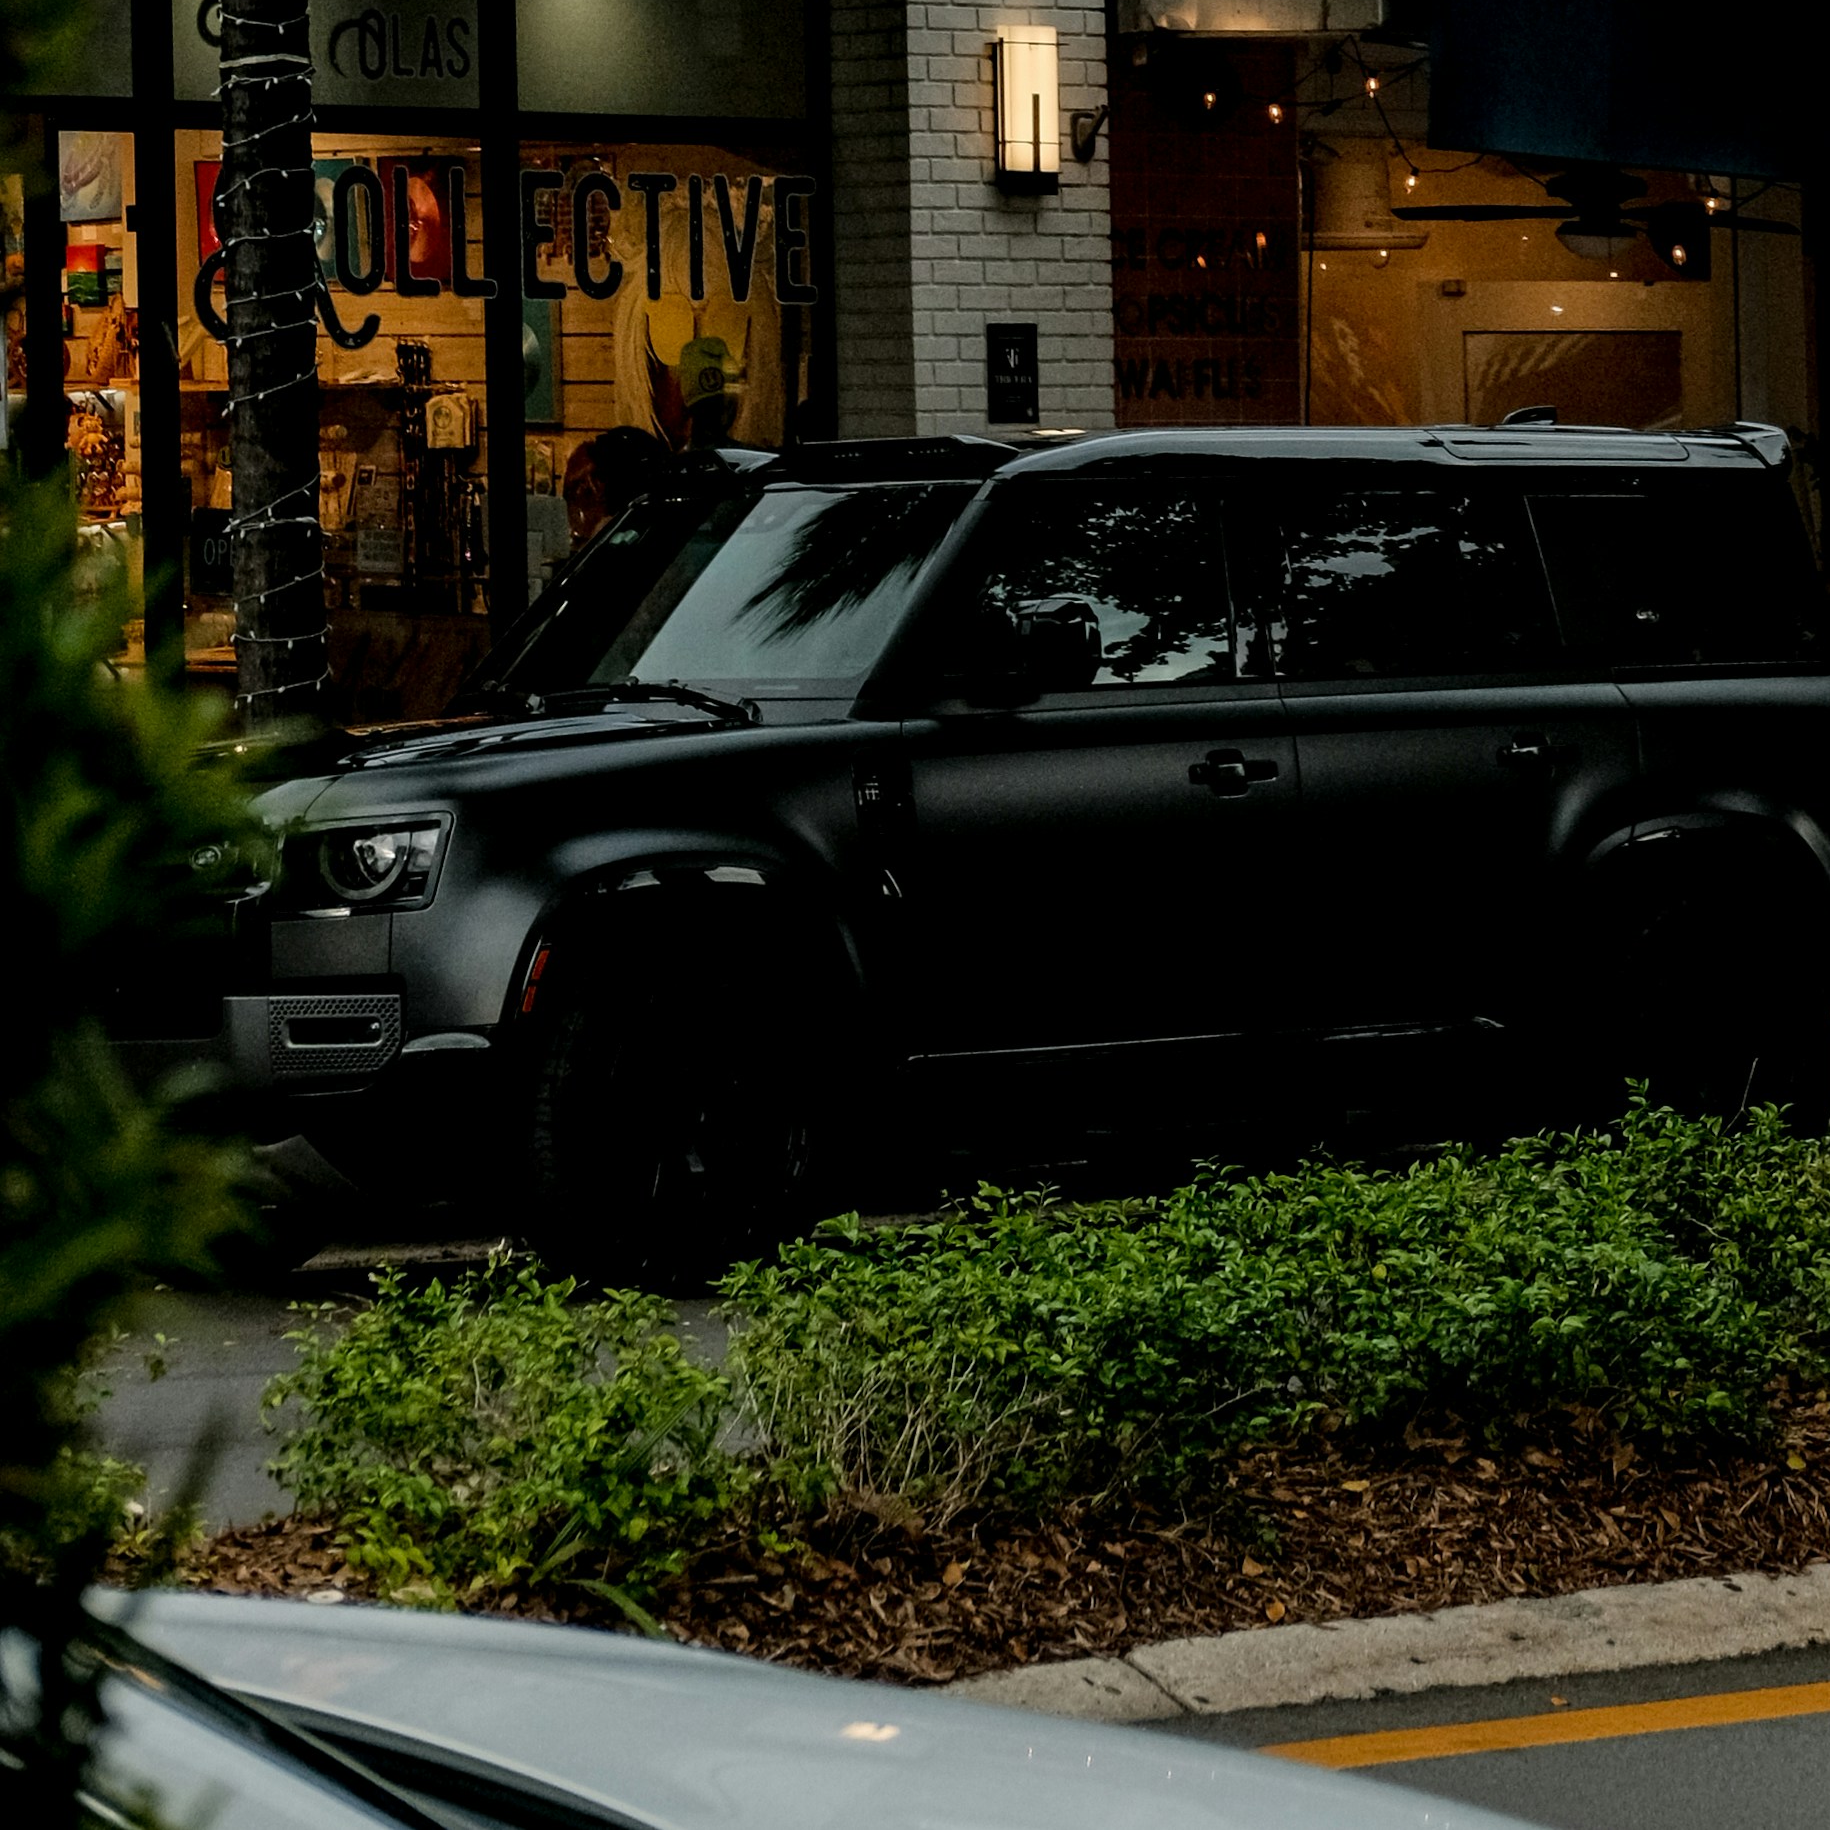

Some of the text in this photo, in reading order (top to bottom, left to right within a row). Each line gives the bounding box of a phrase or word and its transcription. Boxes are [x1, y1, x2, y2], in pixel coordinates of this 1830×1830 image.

[195, 165, 818, 347] OLLECTIVE
[1114, 292, 1280, 336] OPSICLES
[203, 537, 237, 567] OPE
